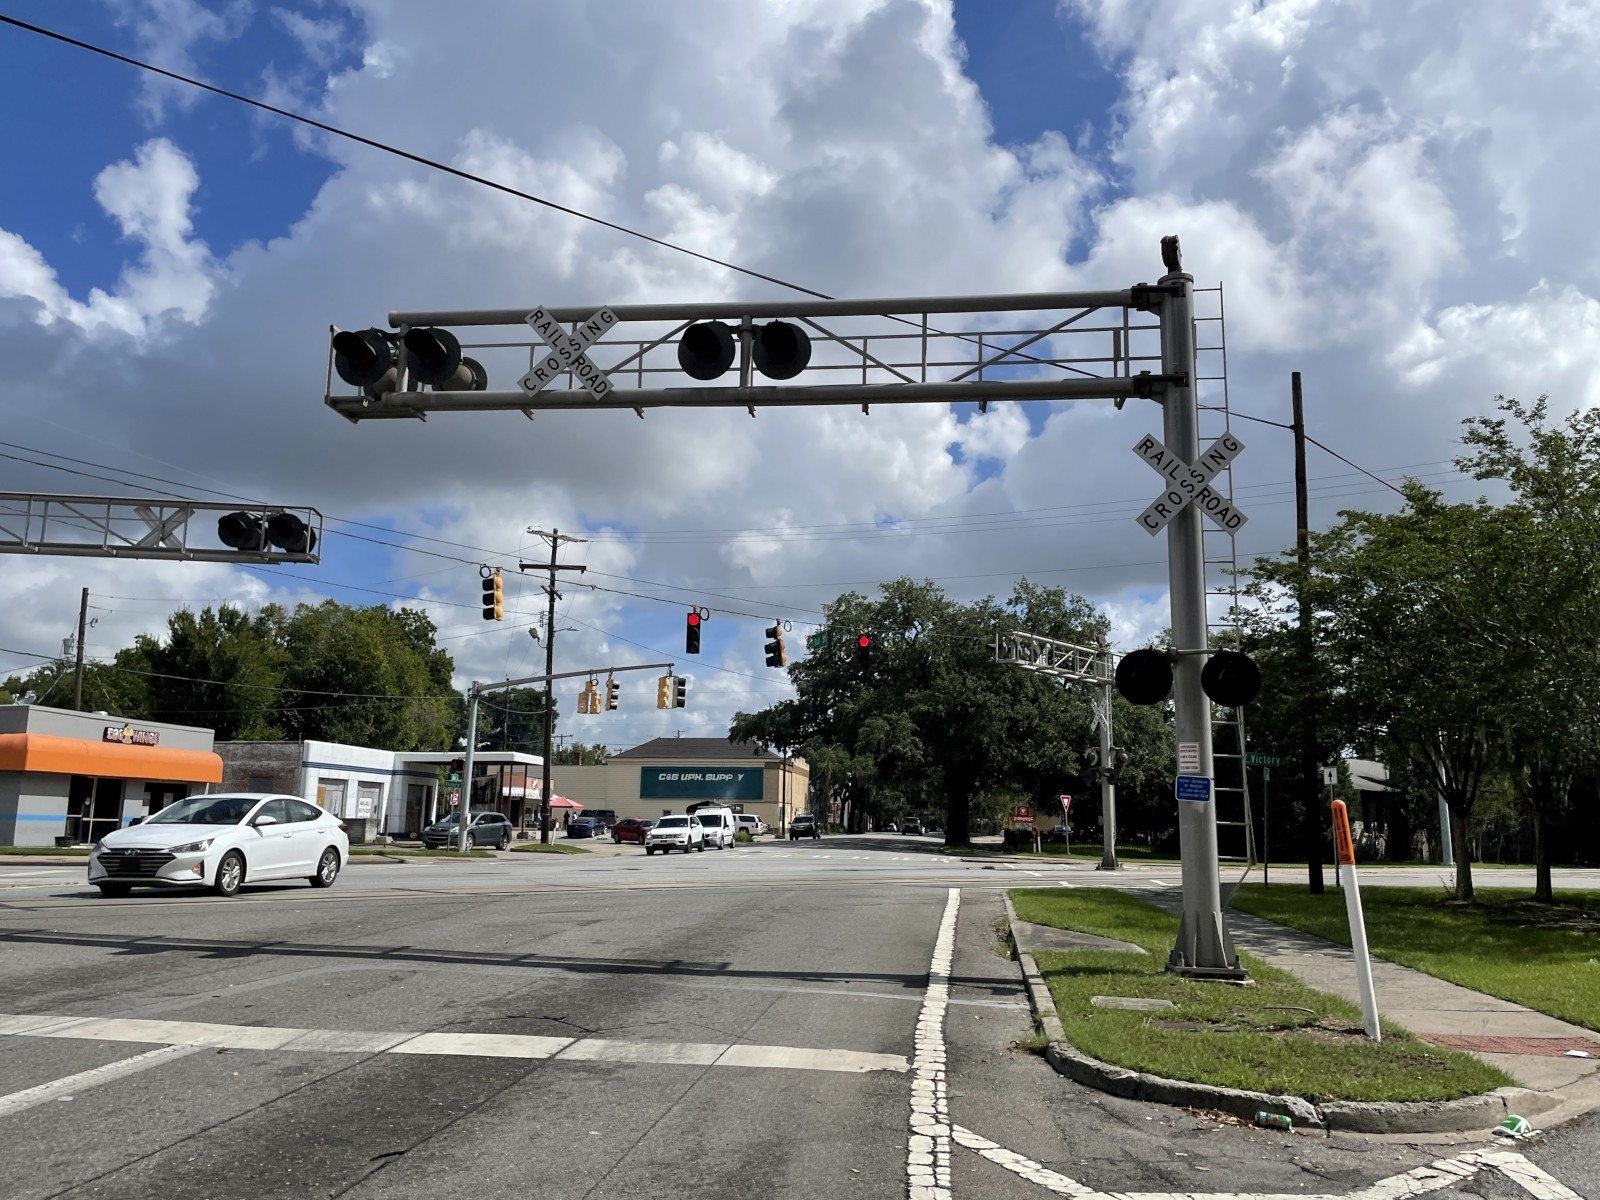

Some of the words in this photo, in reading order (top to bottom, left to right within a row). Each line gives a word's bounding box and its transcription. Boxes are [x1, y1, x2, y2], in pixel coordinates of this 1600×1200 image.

[524, 311, 613, 391] CROSSING
[1143, 438, 1238, 529] CROSSING
[680, 773, 704, 781] UPH.
[1250, 753, 1281, 767] Victory
